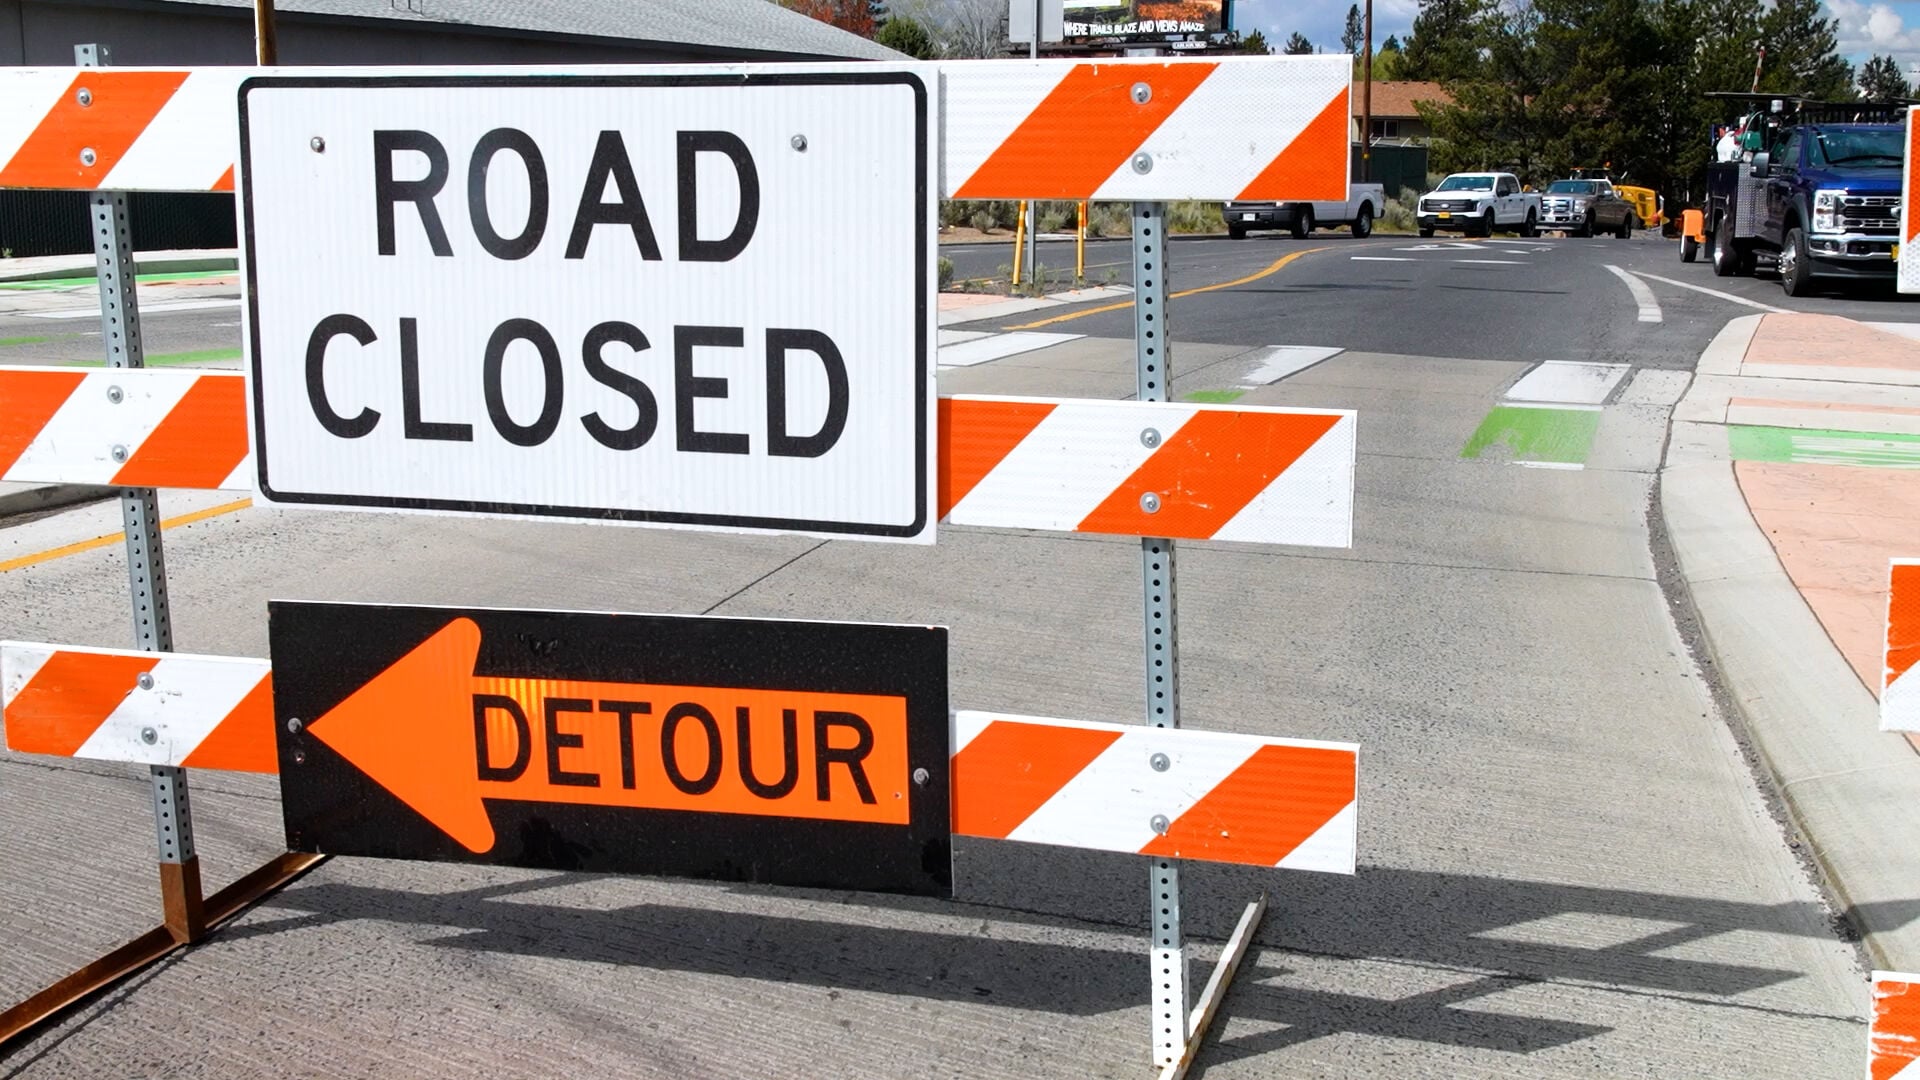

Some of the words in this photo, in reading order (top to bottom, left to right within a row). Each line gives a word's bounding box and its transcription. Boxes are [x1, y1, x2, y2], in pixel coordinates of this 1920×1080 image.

[1063, 21, 1088, 36] WHERE
[1089, 23, 1113, 35] TRAILS
[1114, 22, 1138, 34] BLAZE
[1138, 20, 1155, 33] AND
[1155, 20, 1178, 33] VIEWS
[1179, 21, 1205, 32] AMAZE
[373, 127, 761, 262] ROAD
[305, 314, 849, 459] CLOSED
[473, 694, 878, 805] DETOUR
